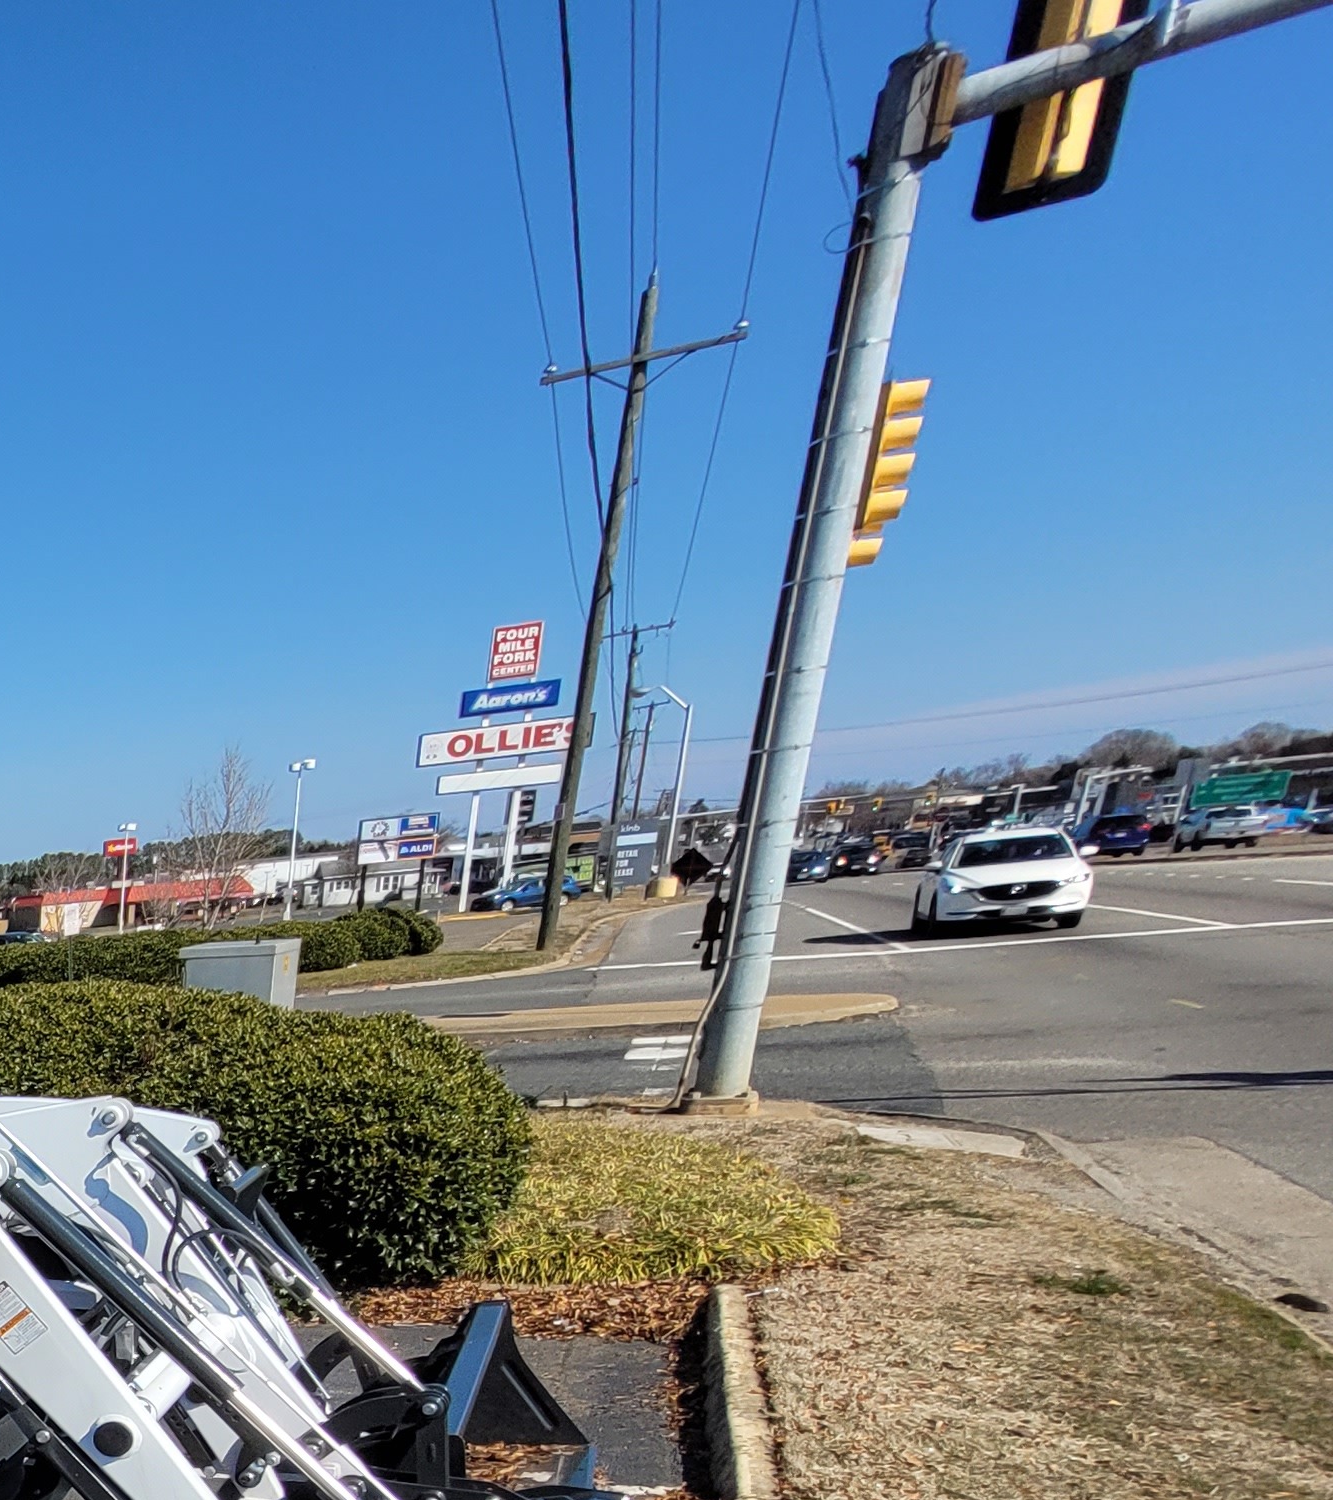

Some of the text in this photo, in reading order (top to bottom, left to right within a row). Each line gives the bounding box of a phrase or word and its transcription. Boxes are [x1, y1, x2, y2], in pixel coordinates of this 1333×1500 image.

[496, 625, 540, 643] FOUR
[497, 638, 535, 653] MILE
[493, 649, 536, 666] FORK
[492, 664, 535, 676] CENTER
[471, 688, 548, 711] Aaron's
[409, 843, 433, 853] ALDI
[616, 849, 639, 859] RETAIL
[615, 859, 630, 868] FOR
[614, 867, 635, 877] LEASE
